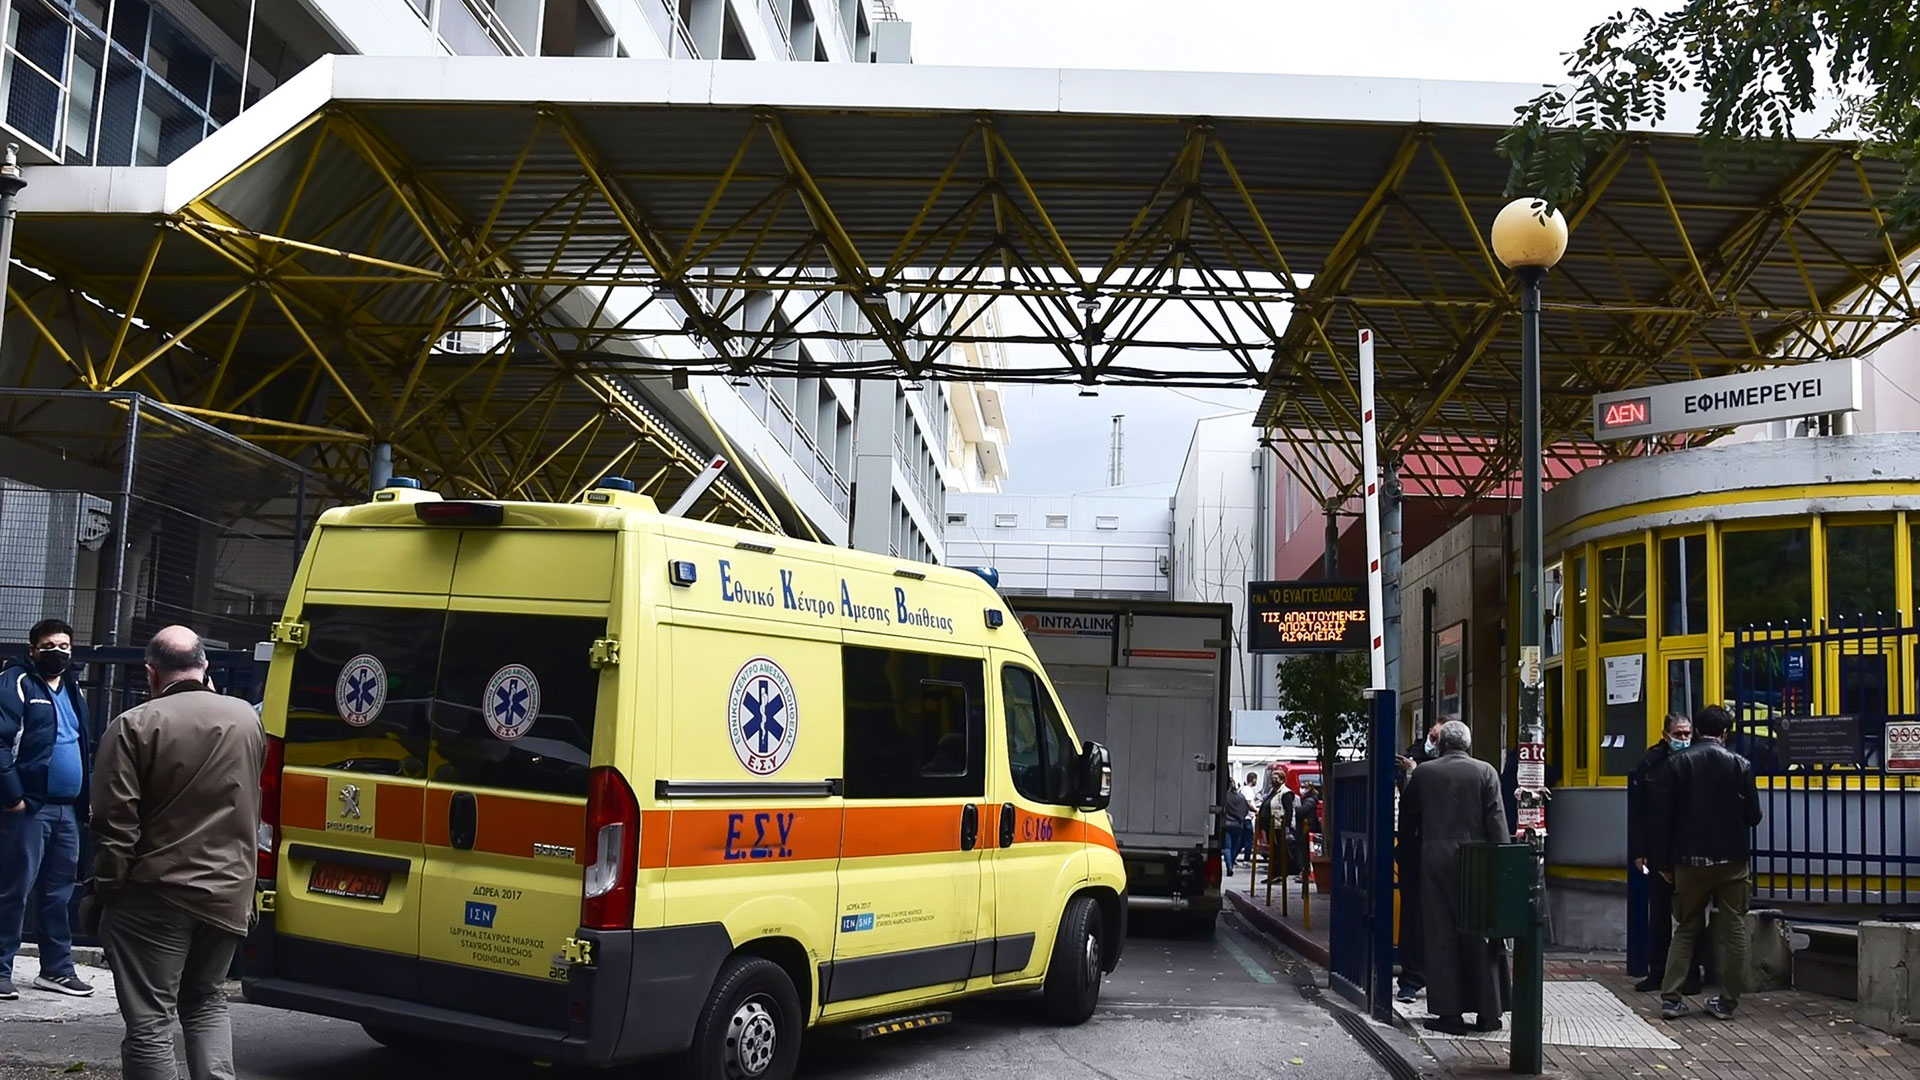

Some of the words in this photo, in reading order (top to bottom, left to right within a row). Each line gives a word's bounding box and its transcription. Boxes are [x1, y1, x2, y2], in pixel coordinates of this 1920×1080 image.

[1684, 378, 1822, 414] ΕΦΗΜΕΡΕΥΕΙ
[1605, 403, 1645, 424] ΔΕΝ
[718, 559, 775, 607] Εθνικό
[779, 568, 835, 619] Κέντρο
[840, 578, 890, 626] Αμεσης
[894, 586, 953, 635] Βοήθειας
[1041, 615, 1113, 630] INTRALINK
[1261, 612, 1280, 623] ΤΙΣ
[1284, 610, 1366, 622] ΑΠΑΙΤΟΥΜΕΝΕΣ
[1278, 621, 1347, 632] ΑΠΟΣΤΑΣΕΙΣ
[1281, 631, 1343, 642] ΑΣΦΑΛΕΙΑΣ
[735, 664, 758, 696] ΚΕΝΤΡΟ
[759, 663, 785, 688] ΑΜΕΣΗΣ
[731, 698, 741, 745] ΕΘΝΙΚΟ
[747, 755, 777, 771] Ε.Σ.Υ
[327, 821, 373, 834] PEUGEOT
[1035, 817, 1053, 841] 166
[724, 813, 794, 860] Ε.Σ.Υ.
[534, 842, 575, 858] BOXER
[472, 886, 499, 898] ΔΩΡΕΑ
[501, 889, 522, 900] 2017
[469, 908, 491, 921] ΙΣΝ
[858, 917, 872, 927] SNF
[450, 926, 476, 938] ΙΔΡΥΜΑ
[478, 930, 512, 944] ΣΤΑΥΡΟΣ
[512, 937, 545, 949] ΝΙΑΡΧΟΣ
[461, 940, 492, 952] STAVROS
[493, 945, 532, 958] NIARCHOS
[472, 951, 520, 967] FOUNDATION
